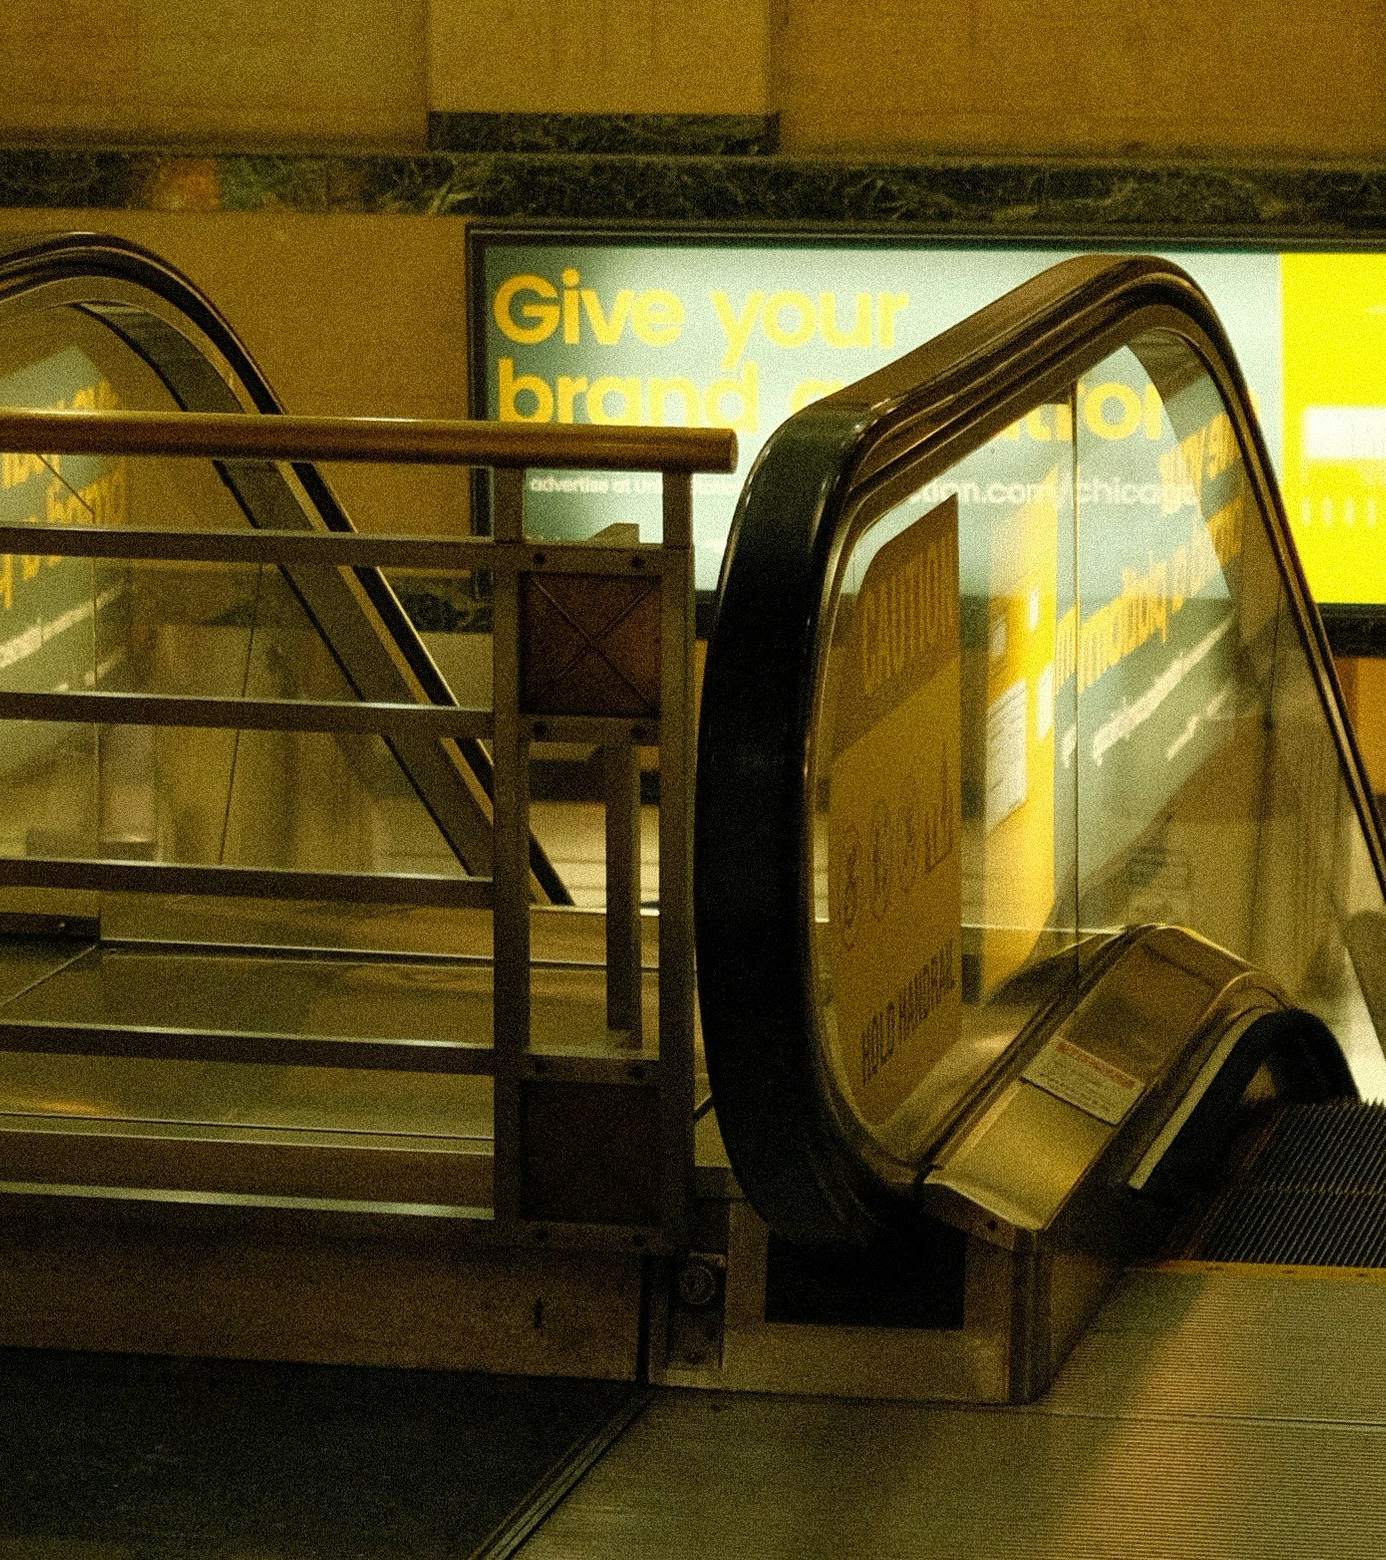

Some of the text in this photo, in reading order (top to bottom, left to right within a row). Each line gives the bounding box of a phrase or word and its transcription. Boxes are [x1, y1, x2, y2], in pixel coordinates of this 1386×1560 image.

[493, 268, 910, 373] Give your
[497, 357, 759, 432] brand
[860, 999, 896, 1085] HOLD
